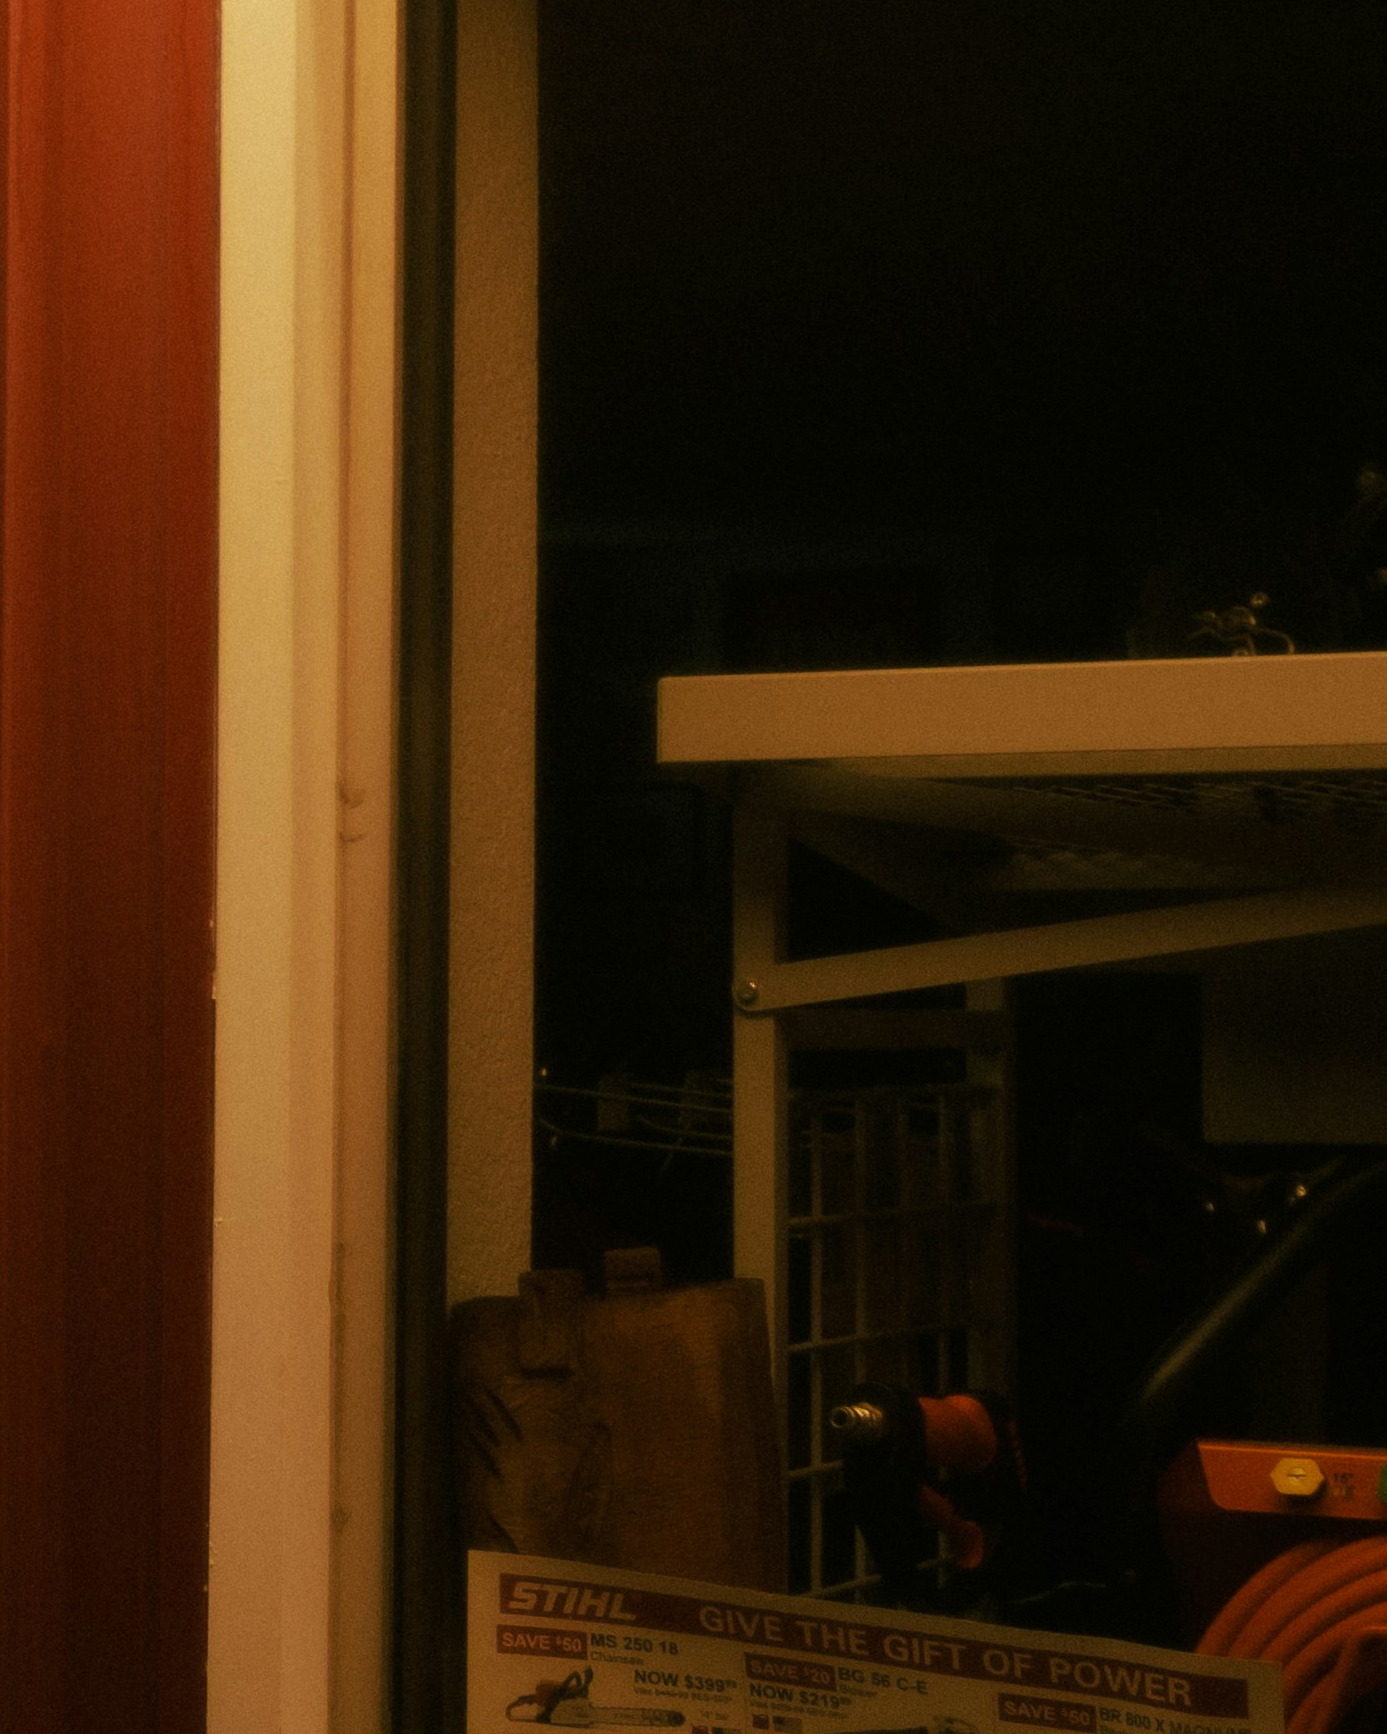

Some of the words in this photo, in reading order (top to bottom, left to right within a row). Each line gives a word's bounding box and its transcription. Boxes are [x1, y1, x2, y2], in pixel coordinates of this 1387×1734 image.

[502, 1632, 551, 1651] SAVE
[555, 1635, 582, 1653] $50
[508, 1581, 636, 1622] STIHL
[699, 1606, 784, 1642] GIVE
[795, 1620, 870, 1656] THE
[883, 1633, 967, 1670] GIFT
[982, 1649, 1032, 1679] OF
[1049, 1657, 1194, 1707] POWER
[590, 1632, 617, 1648] MS
[622, 1635, 653, 1654] 250
[659, 1640, 679, 1656] 18
[634, 1669, 679, 1687] NOW
[750, 1659, 797, 1680] SAVE
[802, 1667, 831, 1685] $20
[838, 1667, 865, 1684] BG
[896, 1676, 928, 1695] C-E
[749, 1683, 793, 1702] NOW
[1003, 1700, 1056, 1721] SAVE
[1100, 1706, 1121, 1724] BR
[1155, 1715, 1166, 1732] X
